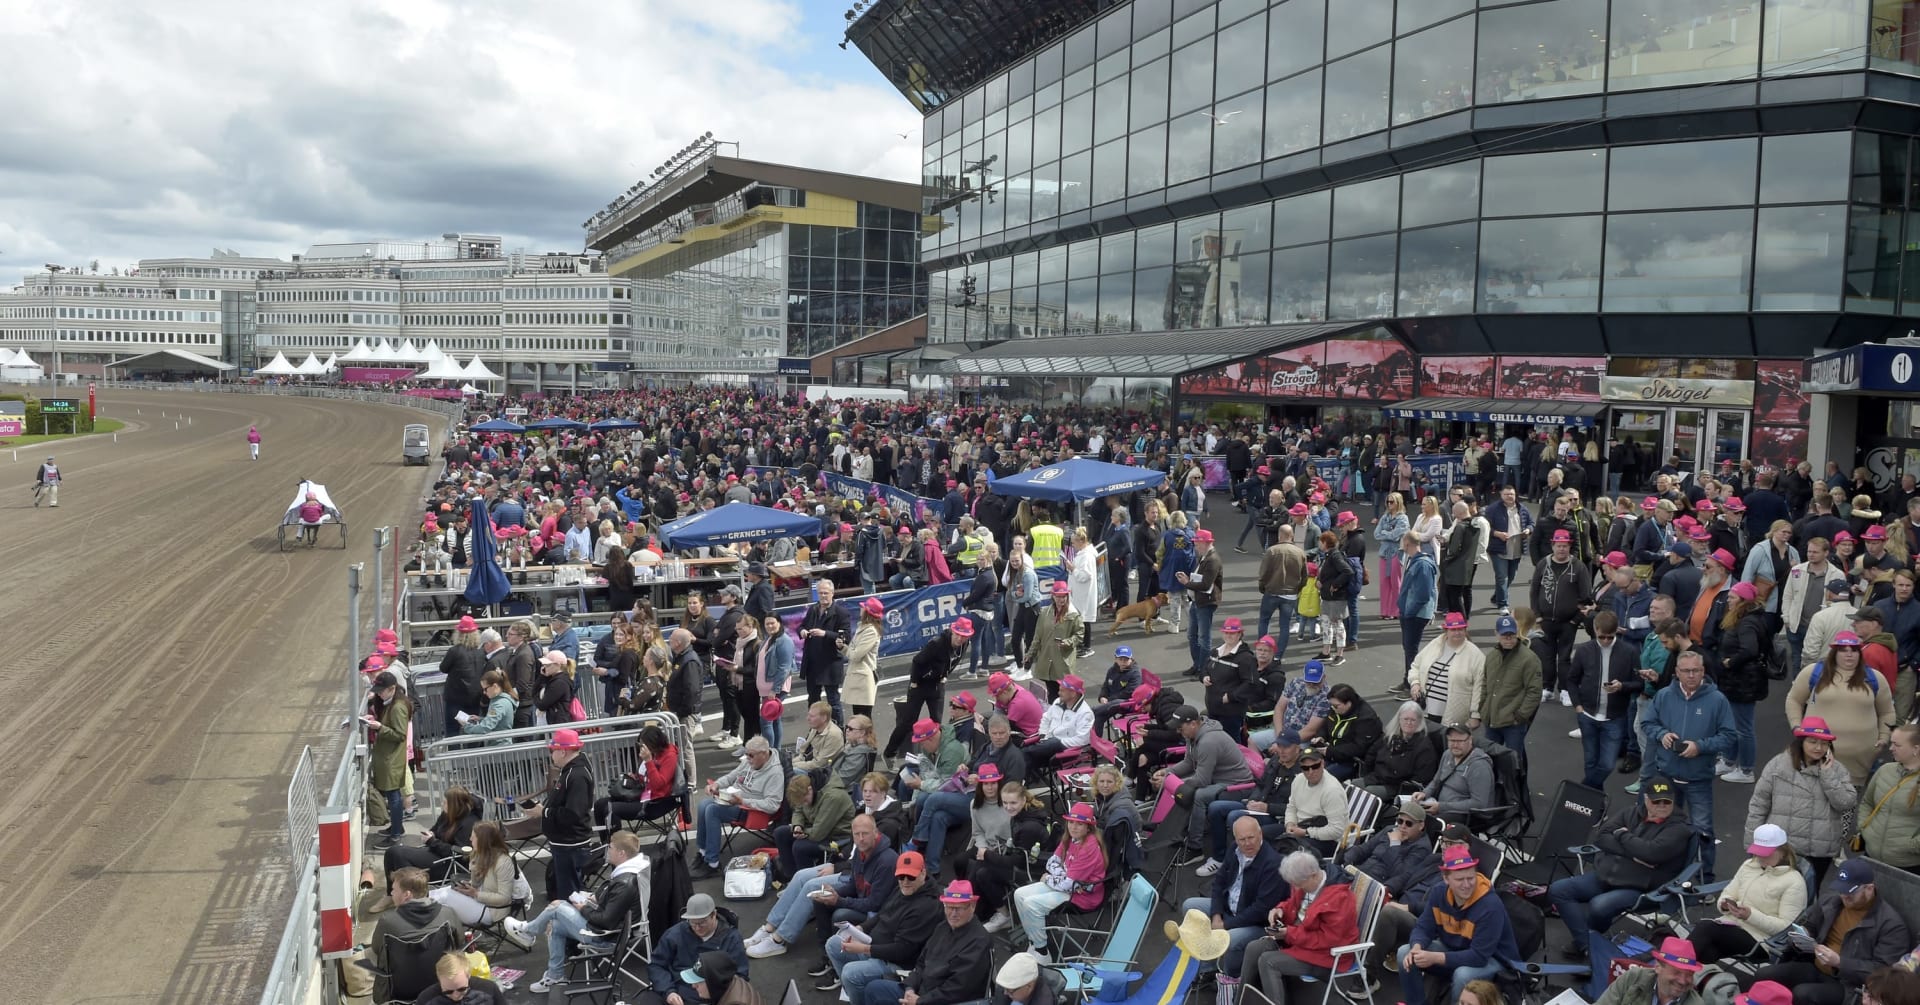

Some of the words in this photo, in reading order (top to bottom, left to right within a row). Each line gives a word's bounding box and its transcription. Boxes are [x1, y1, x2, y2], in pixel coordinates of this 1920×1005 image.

[1273, 371, 1317, 386] Ströget
[1400, 410, 1414, 418] BAR
[1489, 413, 1524, 422] GRILL
[1526, 415, 1535, 423] &
[922, 625, 939, 637] EN
[1564, 800, 1593, 817] SWEROCK
